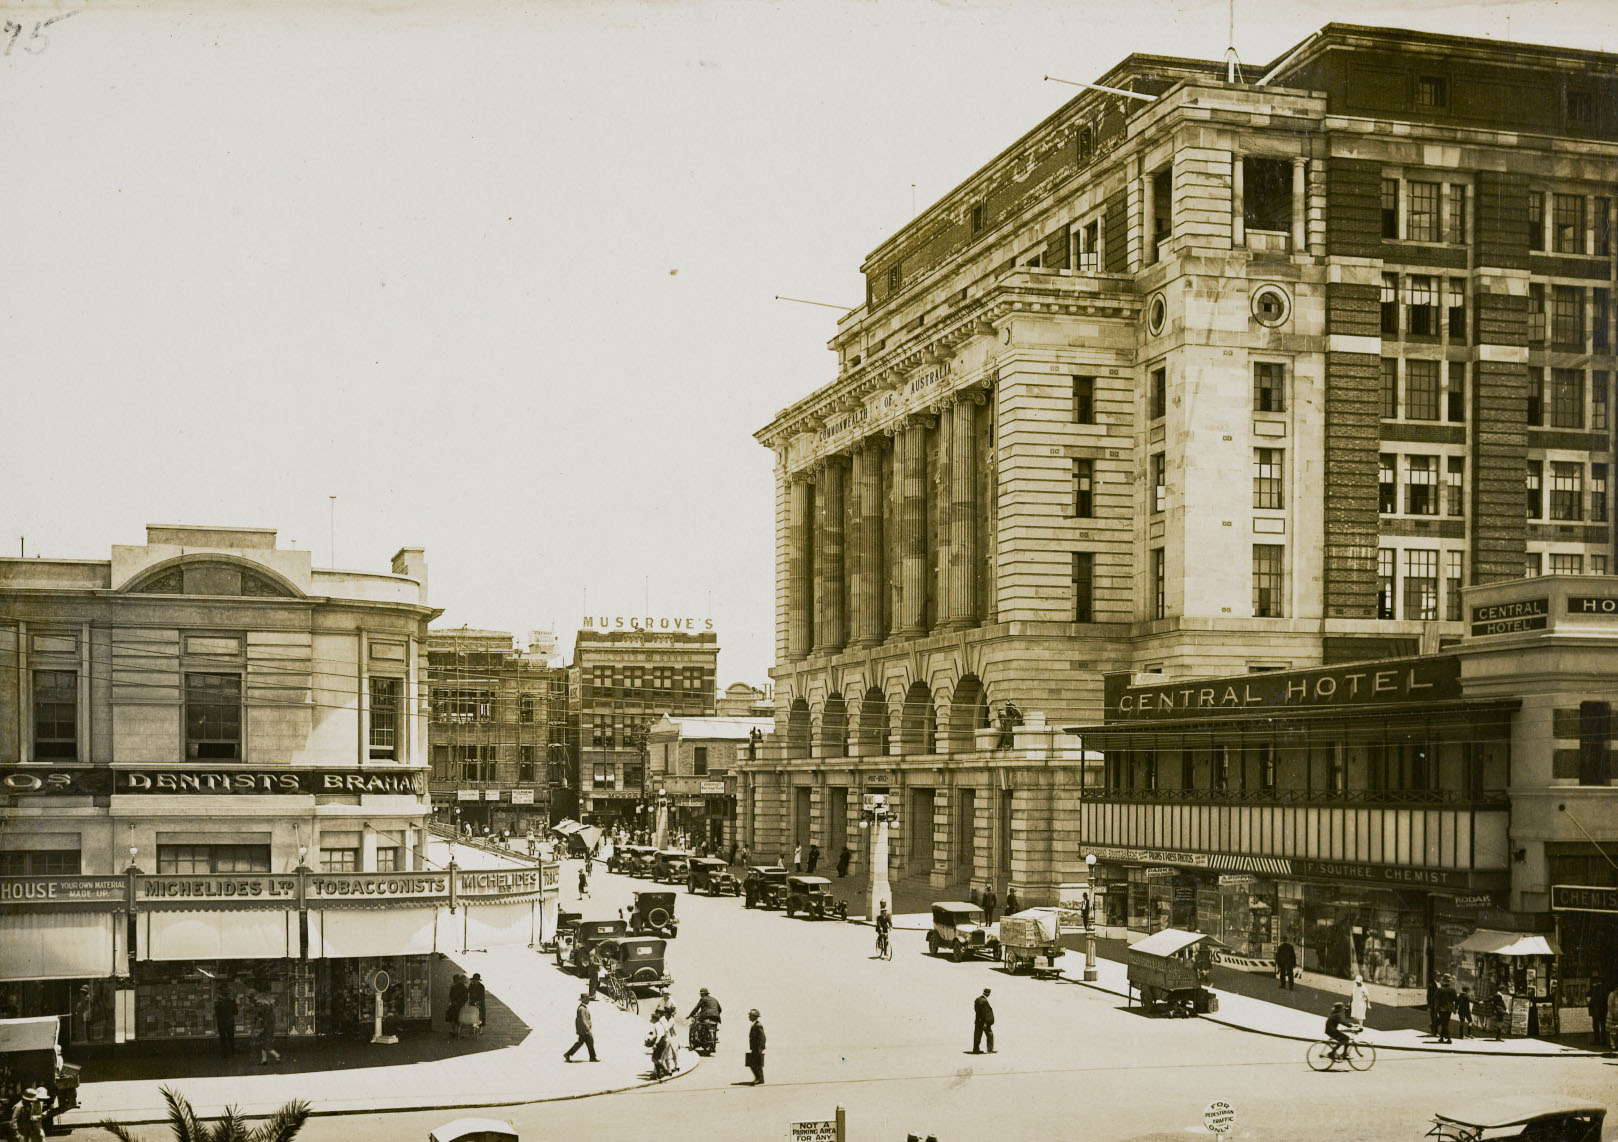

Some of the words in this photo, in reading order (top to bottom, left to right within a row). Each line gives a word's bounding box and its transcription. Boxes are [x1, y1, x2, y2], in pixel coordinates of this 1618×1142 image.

[818, 407, 868, 442] COMMONWEALTH
[884, 393, 893, 408] OF
[910, 362, 952, 394] AUSTRALIA
[1479, 602, 1541, 620] CENTRAL
[1583, 600, 1616, 611] HO
[583, 616, 714, 629] MUSGROVE'S
[1487, 621, 1531, 634] HOTEL
[1119, 684, 1263, 712] CENTRAL
[1287, 668, 1434, 699] HOTEL
[128, 774, 300, 791] DENTISTS
[461, 872, 537, 889] MICHELIDES
[1384, 868, 1449, 883] CHEMIST
[1, 883, 58, 899] HOUSE
[60, 881, 79, 889] YOUR
[79, 881, 94, 889] OWN
[94, 881, 126, 889] MATERIAL
[144, 880, 262, 897] MICHELIDES
[313, 878, 446, 895] TOBACCONISTS
[1455, 895, 1491, 904] KODAK
[1211, 1101, 1230, 1109] FOR
[800, 1121, 818, 1129] NOT
[1209, 1124, 1229, 1133] ONLY
